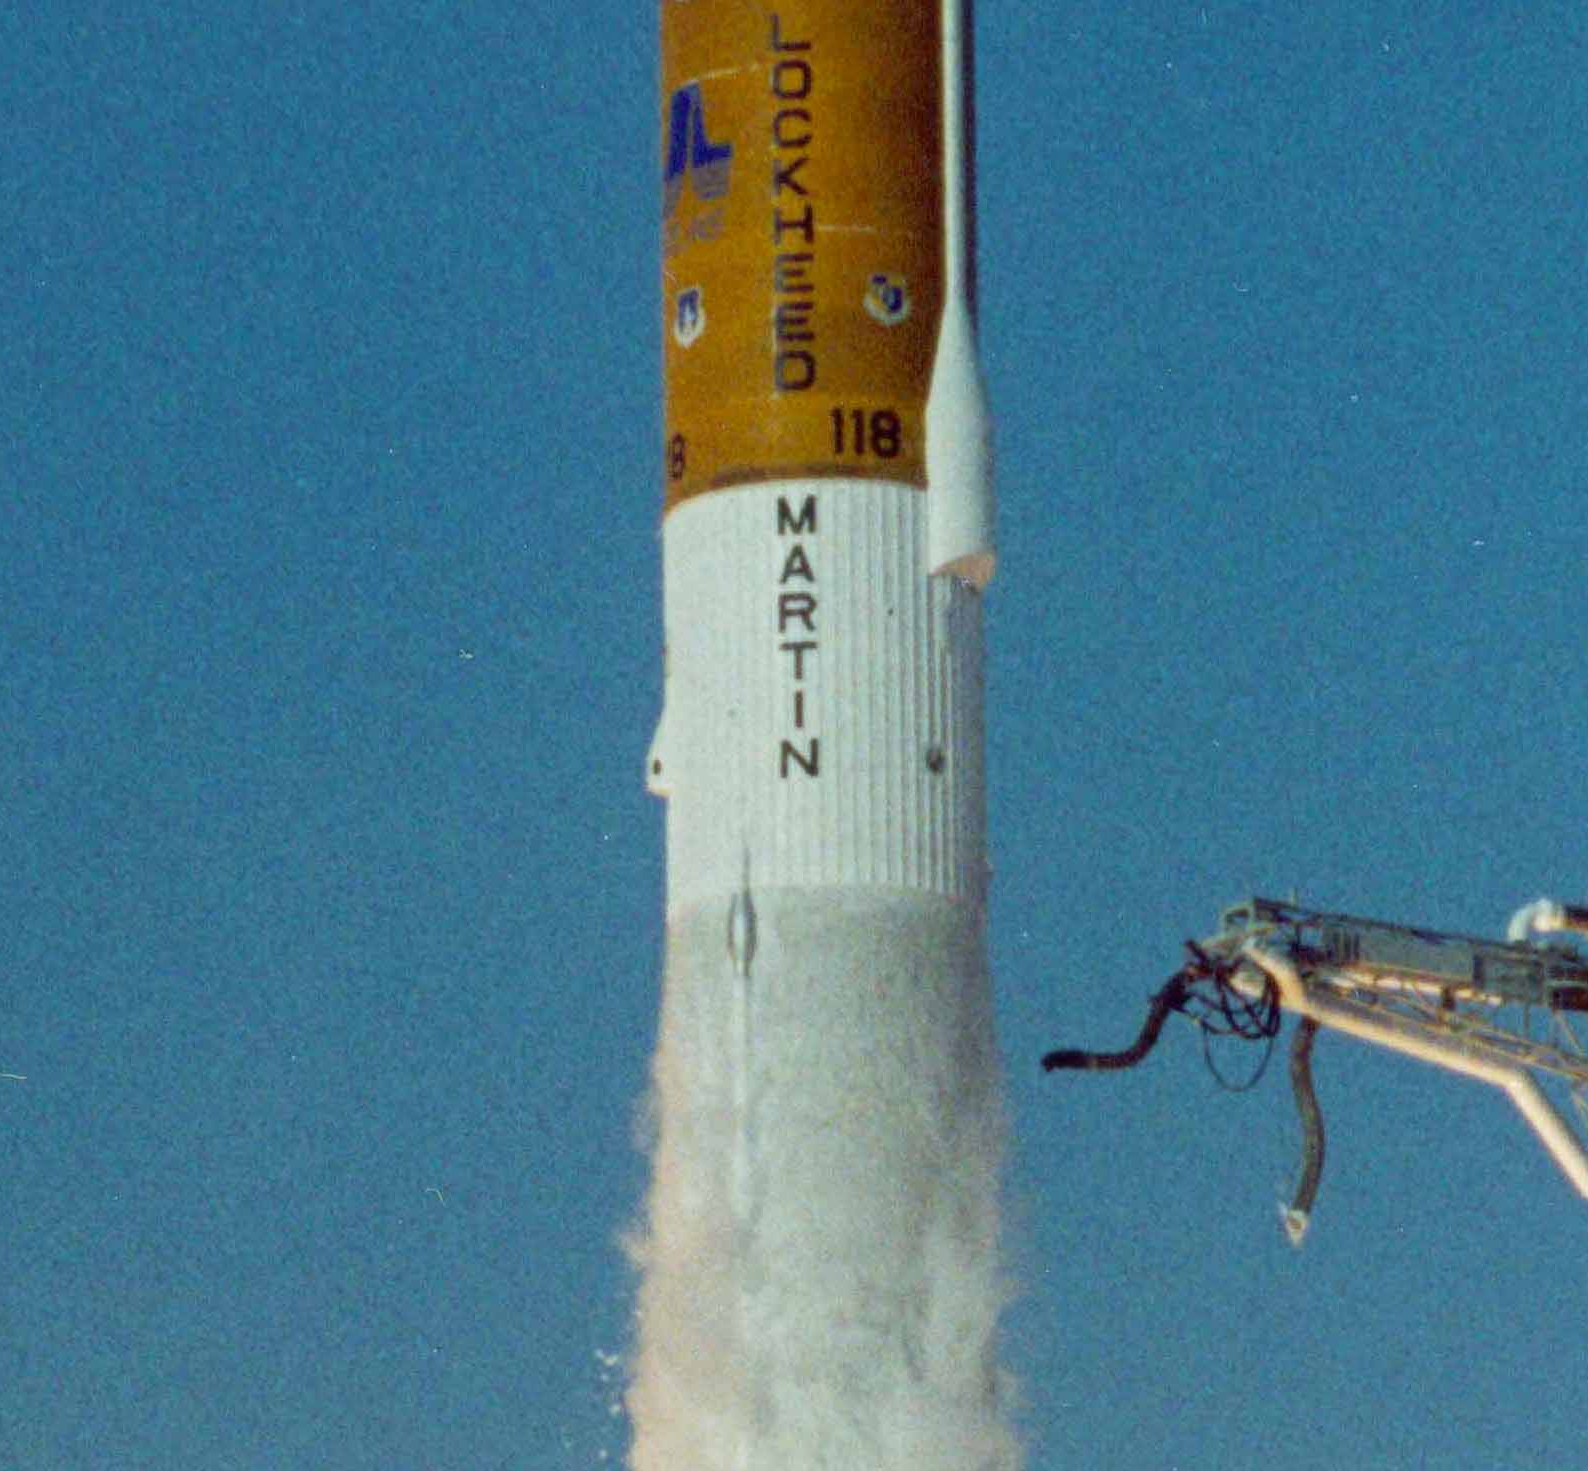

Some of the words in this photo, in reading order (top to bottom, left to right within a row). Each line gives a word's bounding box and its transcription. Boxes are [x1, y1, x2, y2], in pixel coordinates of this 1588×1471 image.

[770, 13, 816, 391] LOCKHEED
[830, 408, 901, 459] 118
[777, 494, 818, 778] MARTIN
